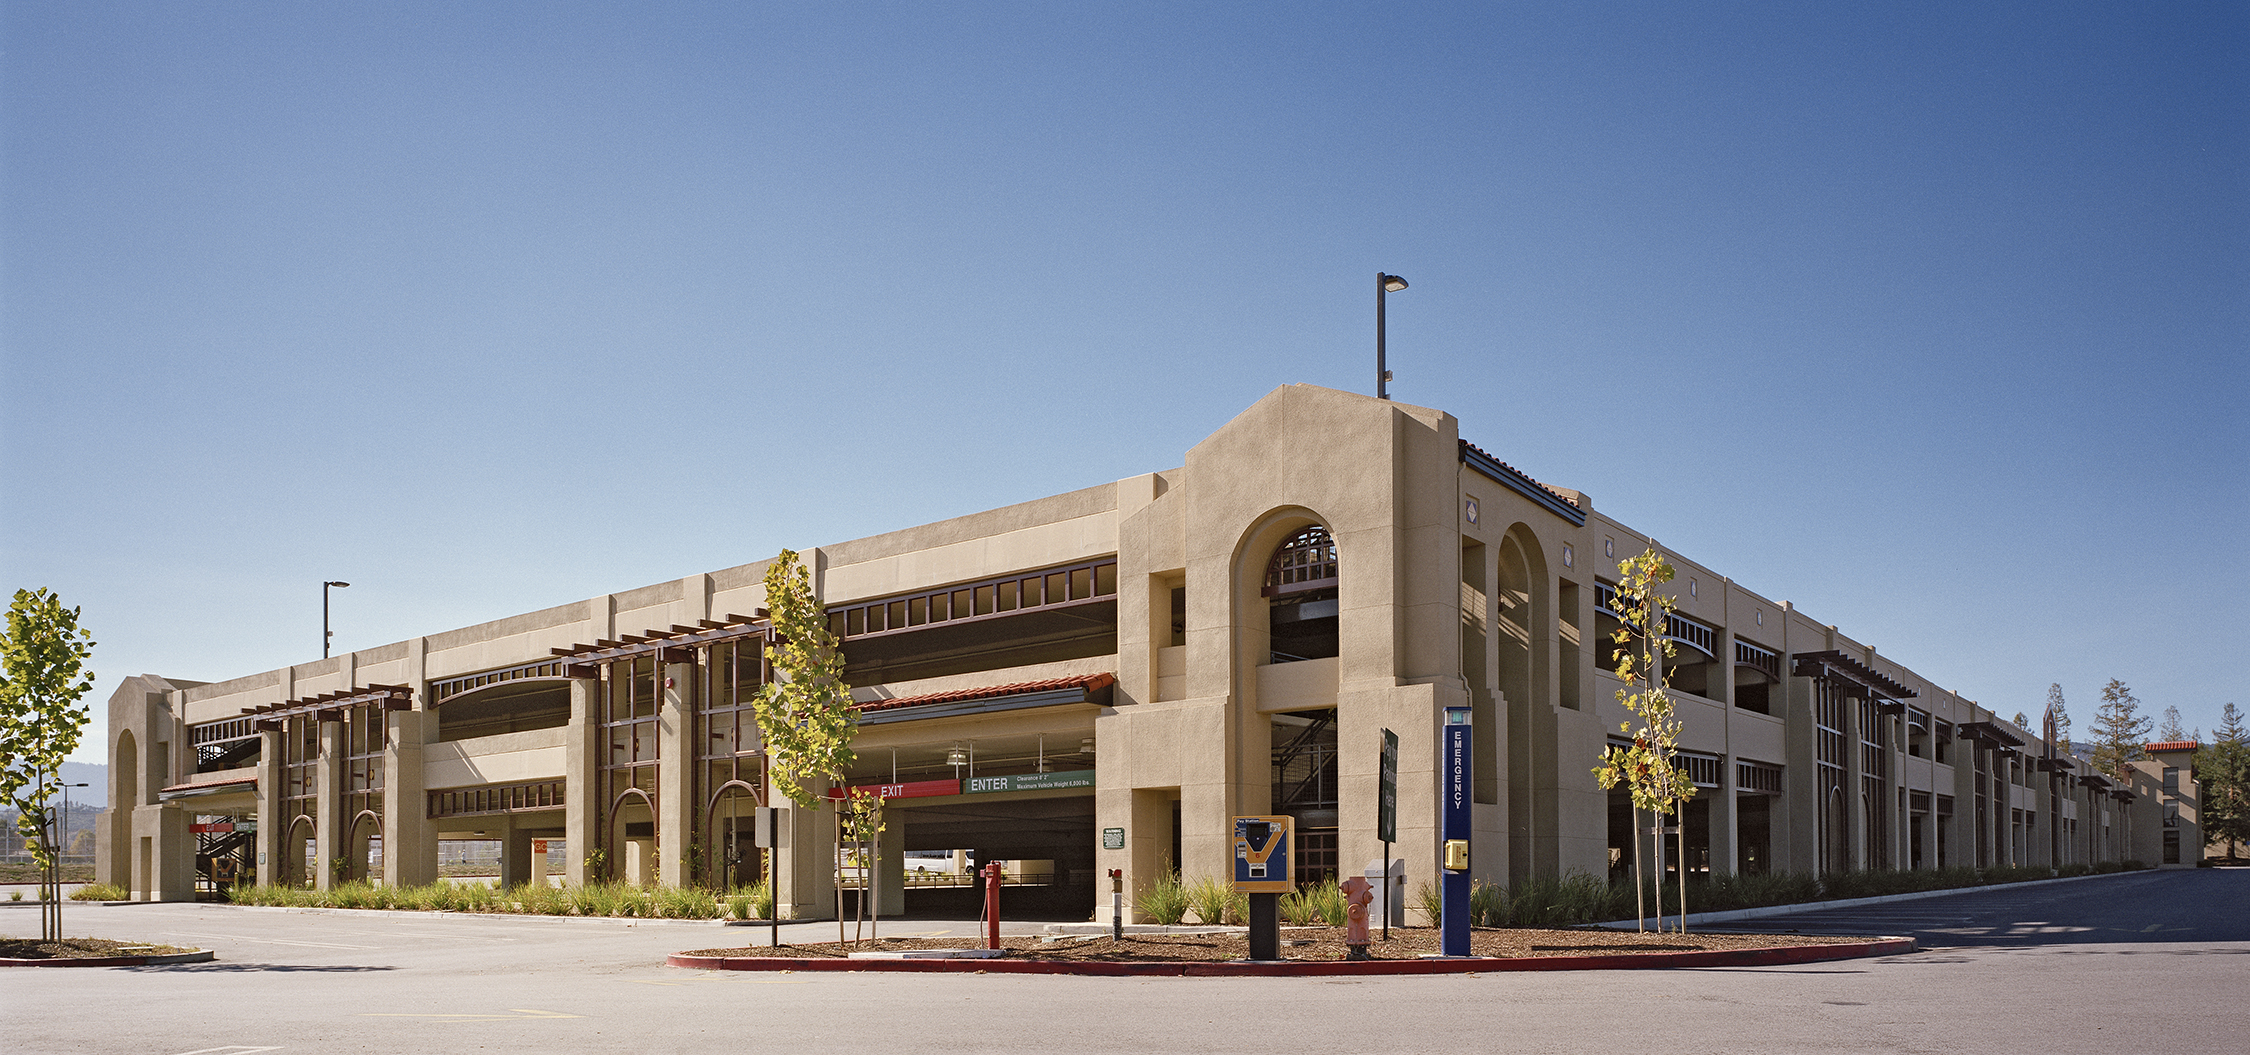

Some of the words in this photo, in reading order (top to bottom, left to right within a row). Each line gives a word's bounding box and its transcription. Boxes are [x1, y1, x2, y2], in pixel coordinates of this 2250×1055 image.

[1454, 731, 1462, 809] EMERGENCY
[881, 784, 904, 797] EXIT
[971, 777, 1008, 791] ENTER
